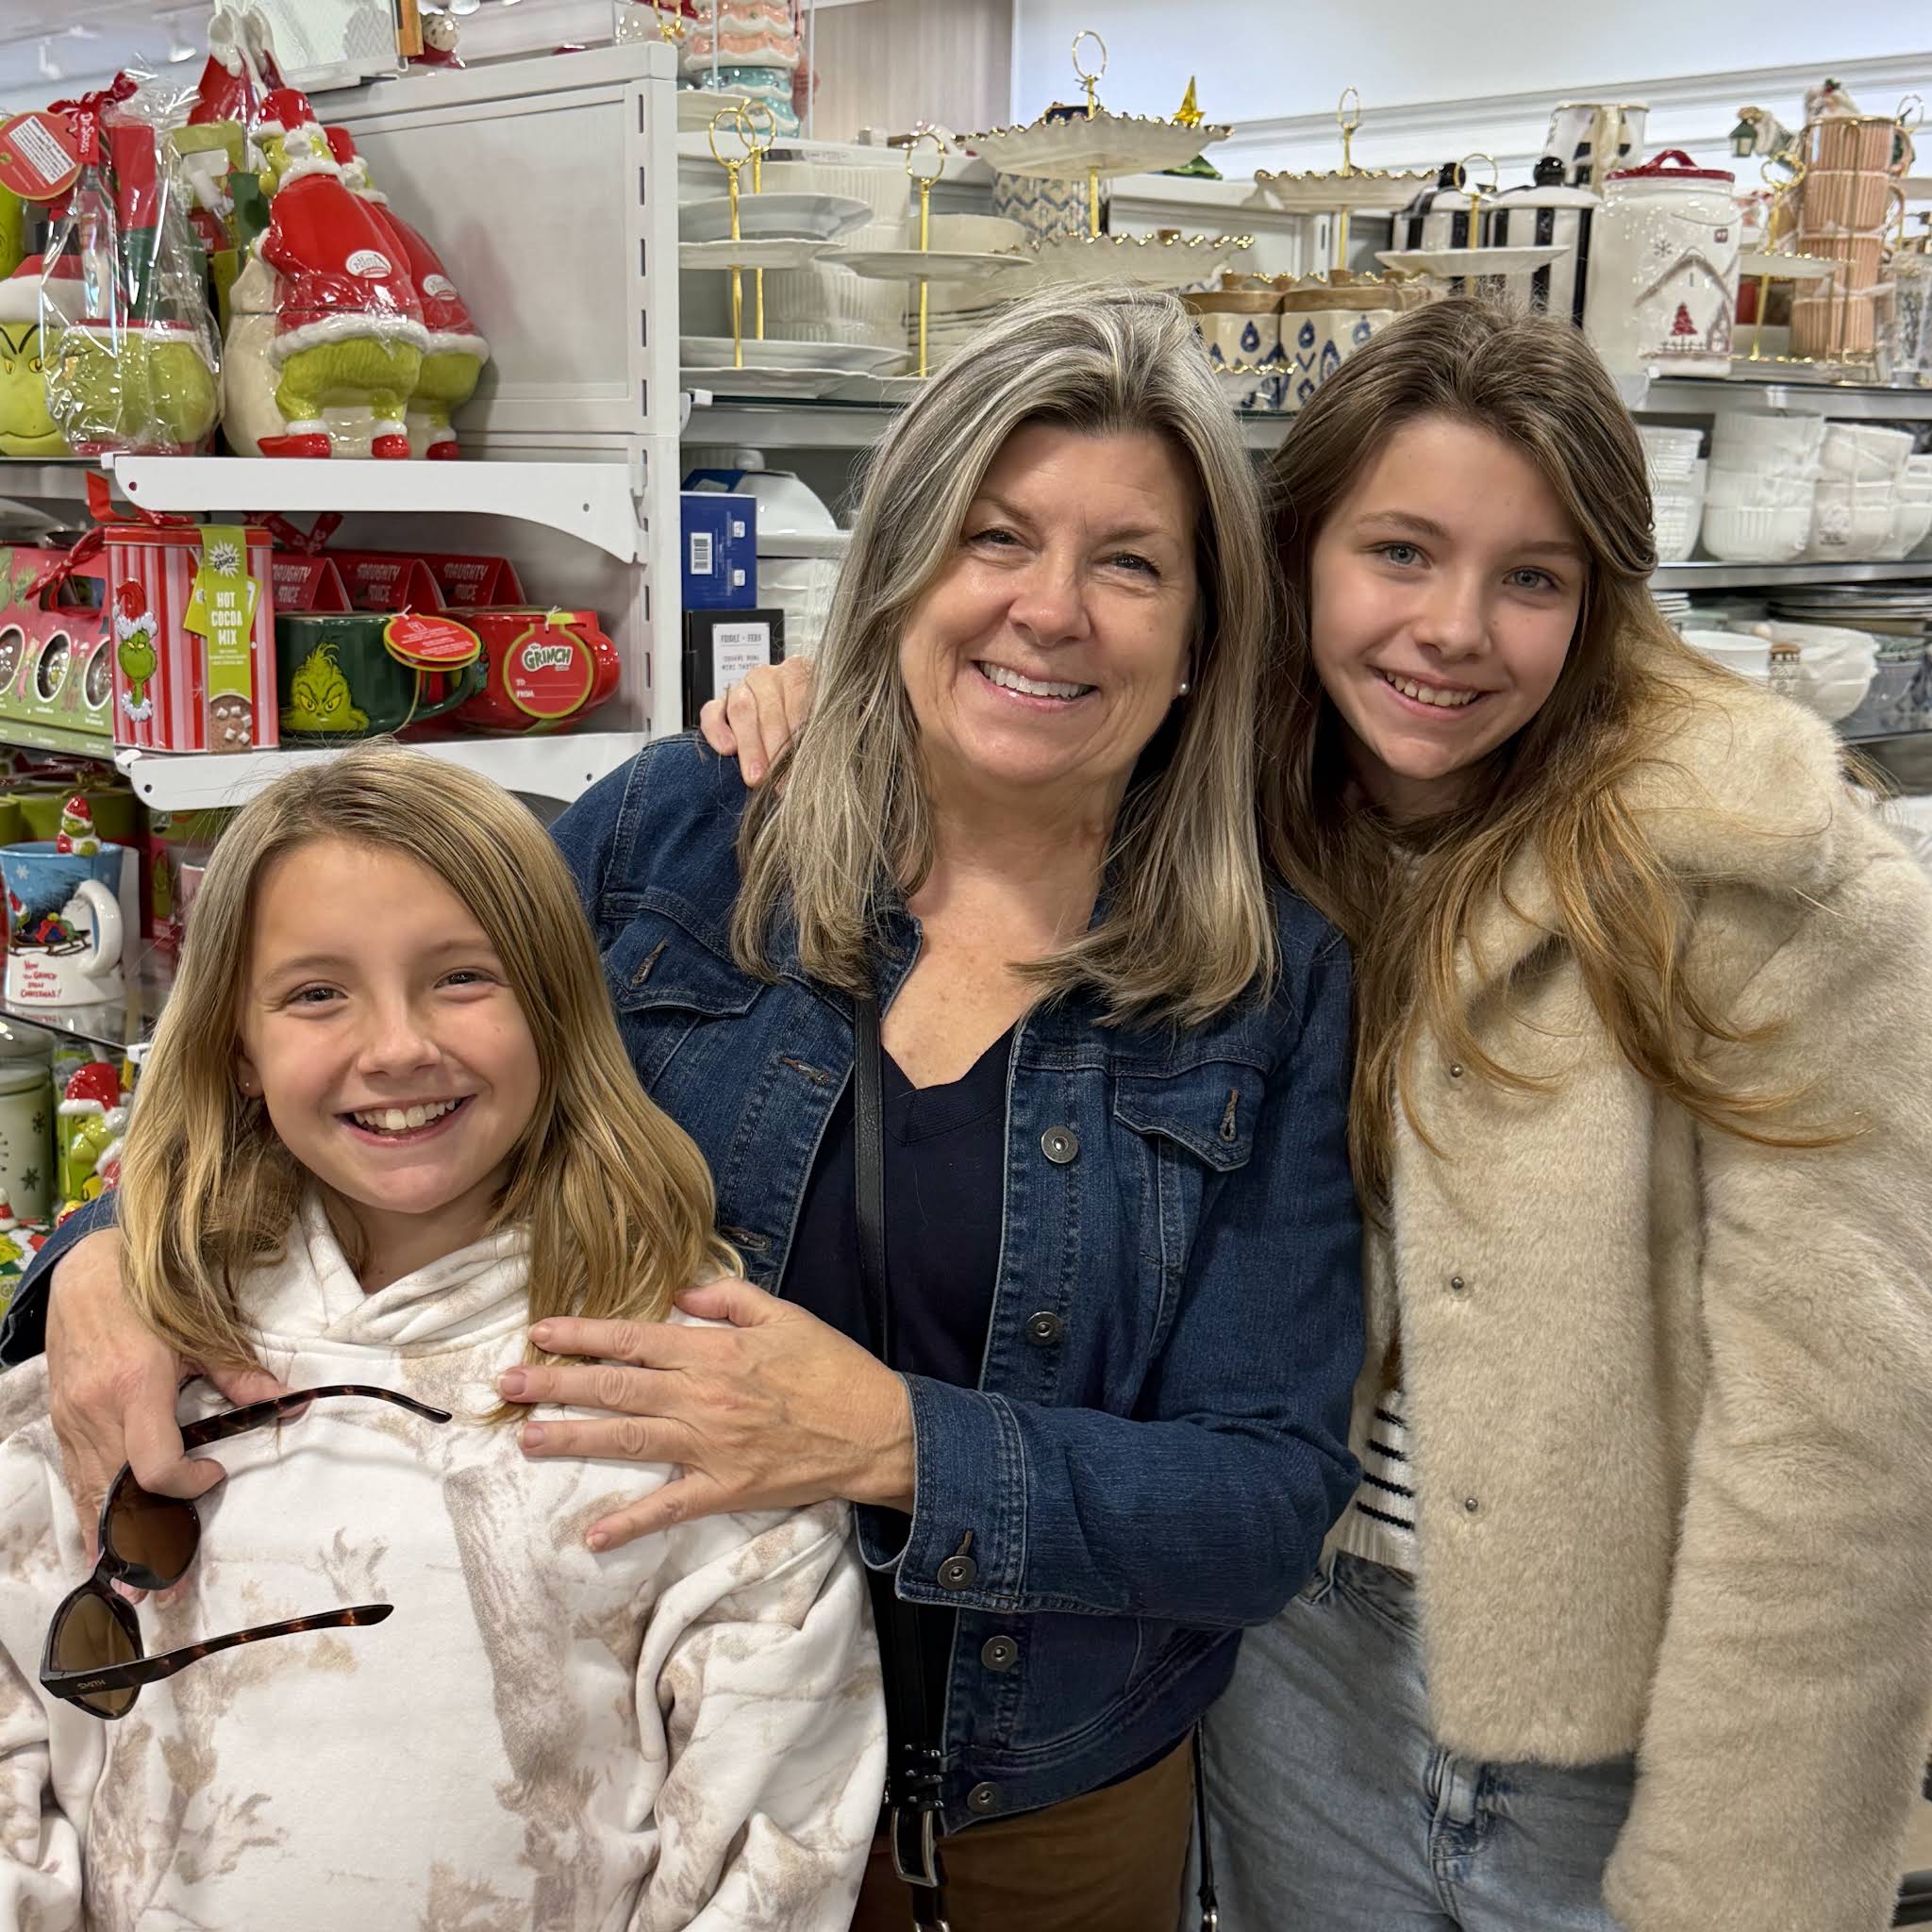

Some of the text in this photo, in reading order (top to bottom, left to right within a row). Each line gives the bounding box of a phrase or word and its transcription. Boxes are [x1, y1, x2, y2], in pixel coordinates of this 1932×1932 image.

[216, 591, 236, 608] HOT
[210, 610, 243, 627] COCOA
[218, 629, 238, 645] MIX
[524, 646, 572, 671] GRINCH
